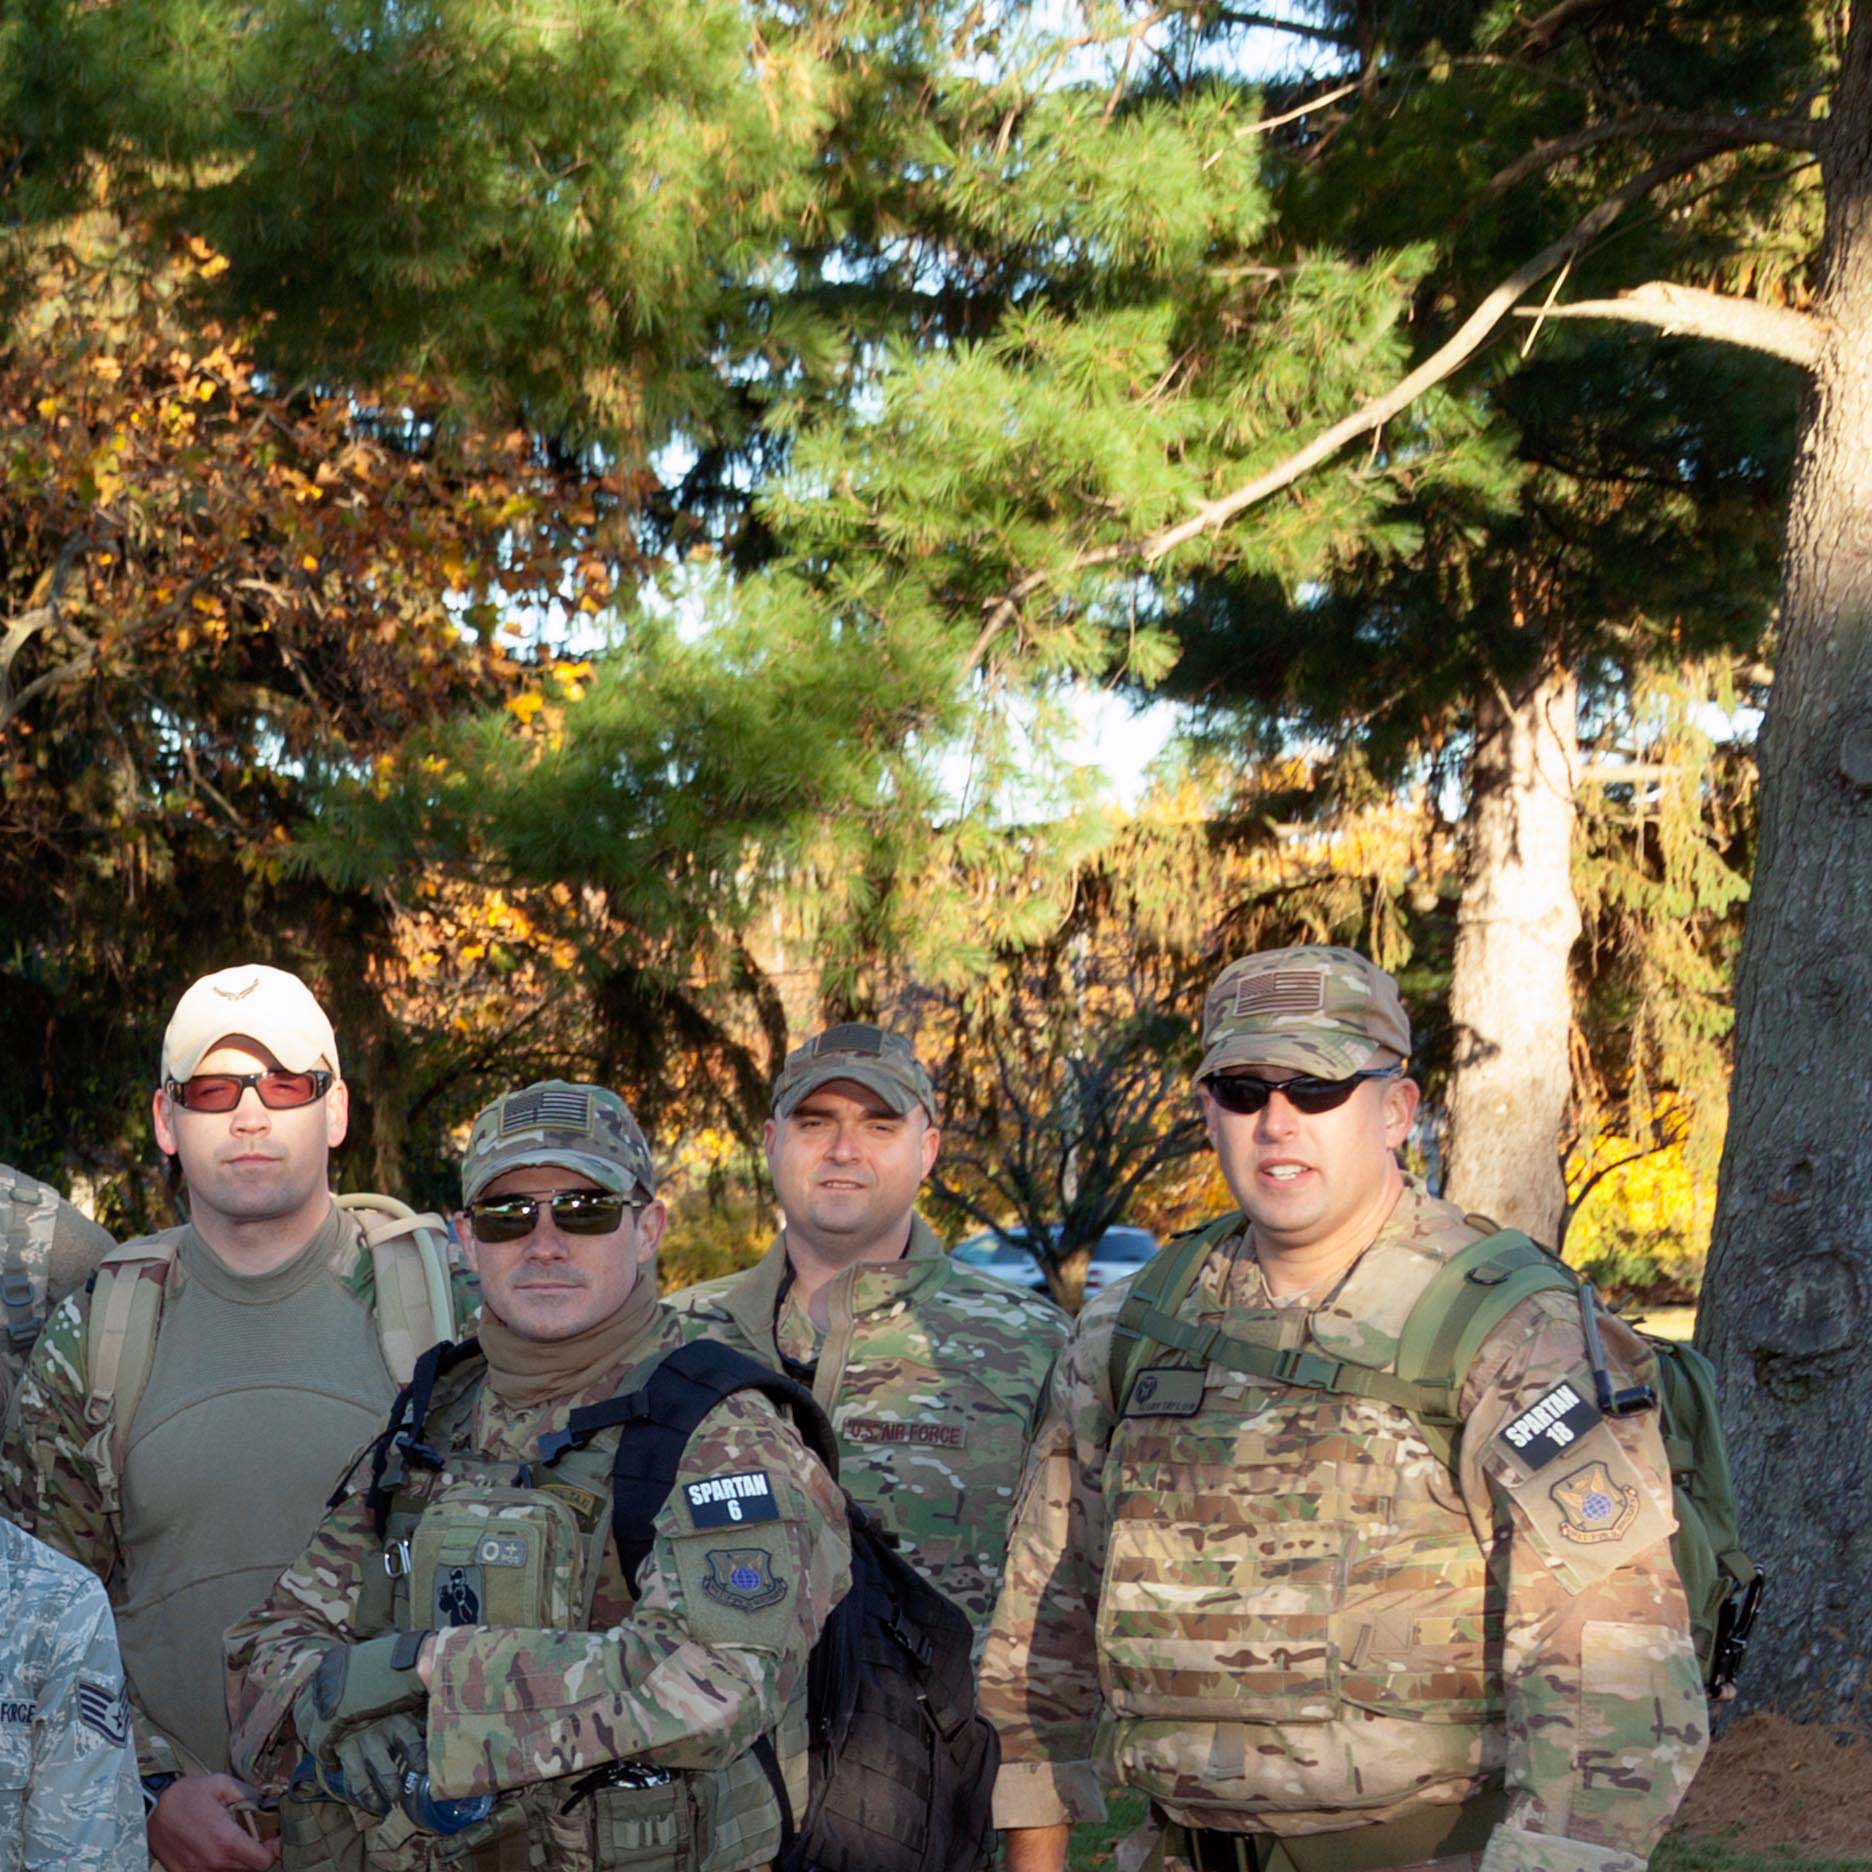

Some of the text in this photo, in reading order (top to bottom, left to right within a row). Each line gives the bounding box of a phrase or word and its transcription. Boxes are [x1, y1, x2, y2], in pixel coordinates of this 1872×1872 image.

[1505, 1384, 1581, 1448] SPARTAN
[909, 1423, 961, 1446] FORCE
[1546, 1421, 1575, 1447] 18
[688, 1473, 769, 1506] SPARTAN
[726, 1499, 743, 1521] 6
[0, 1702, 36, 1724] FORCE
